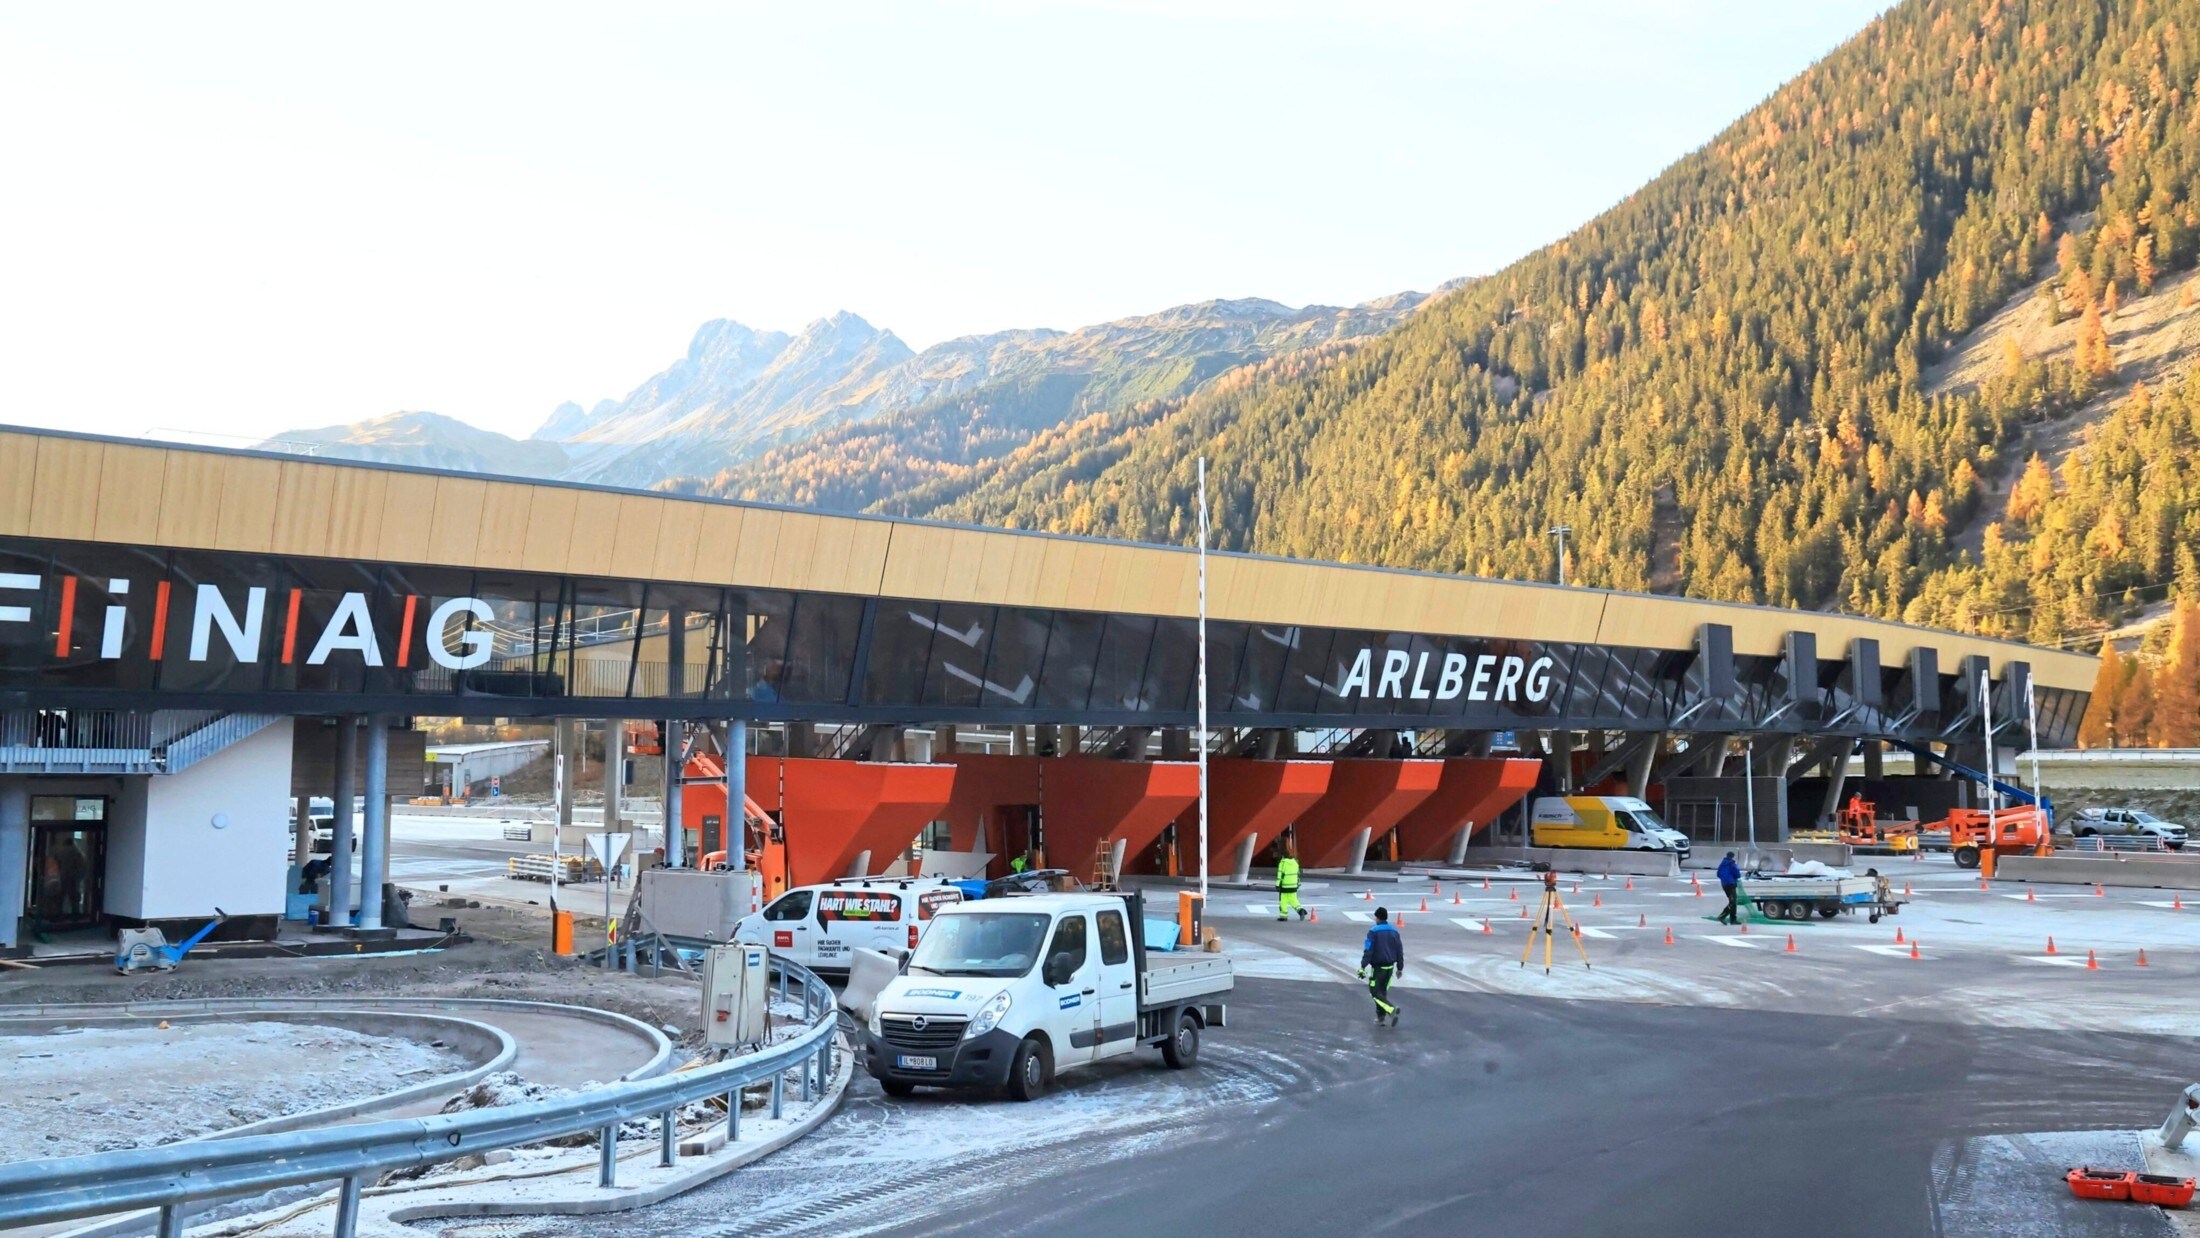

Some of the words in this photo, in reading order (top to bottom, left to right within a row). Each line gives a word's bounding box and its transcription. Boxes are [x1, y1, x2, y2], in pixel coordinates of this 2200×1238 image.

[1339, 648, 1553, 703] ARLBERG
[820, 897, 844, 911] HART
[844, 898, 863, 911] WIE
[863, 898, 898, 912] STAHL?
[908, 989, 957, 998] BODNER
